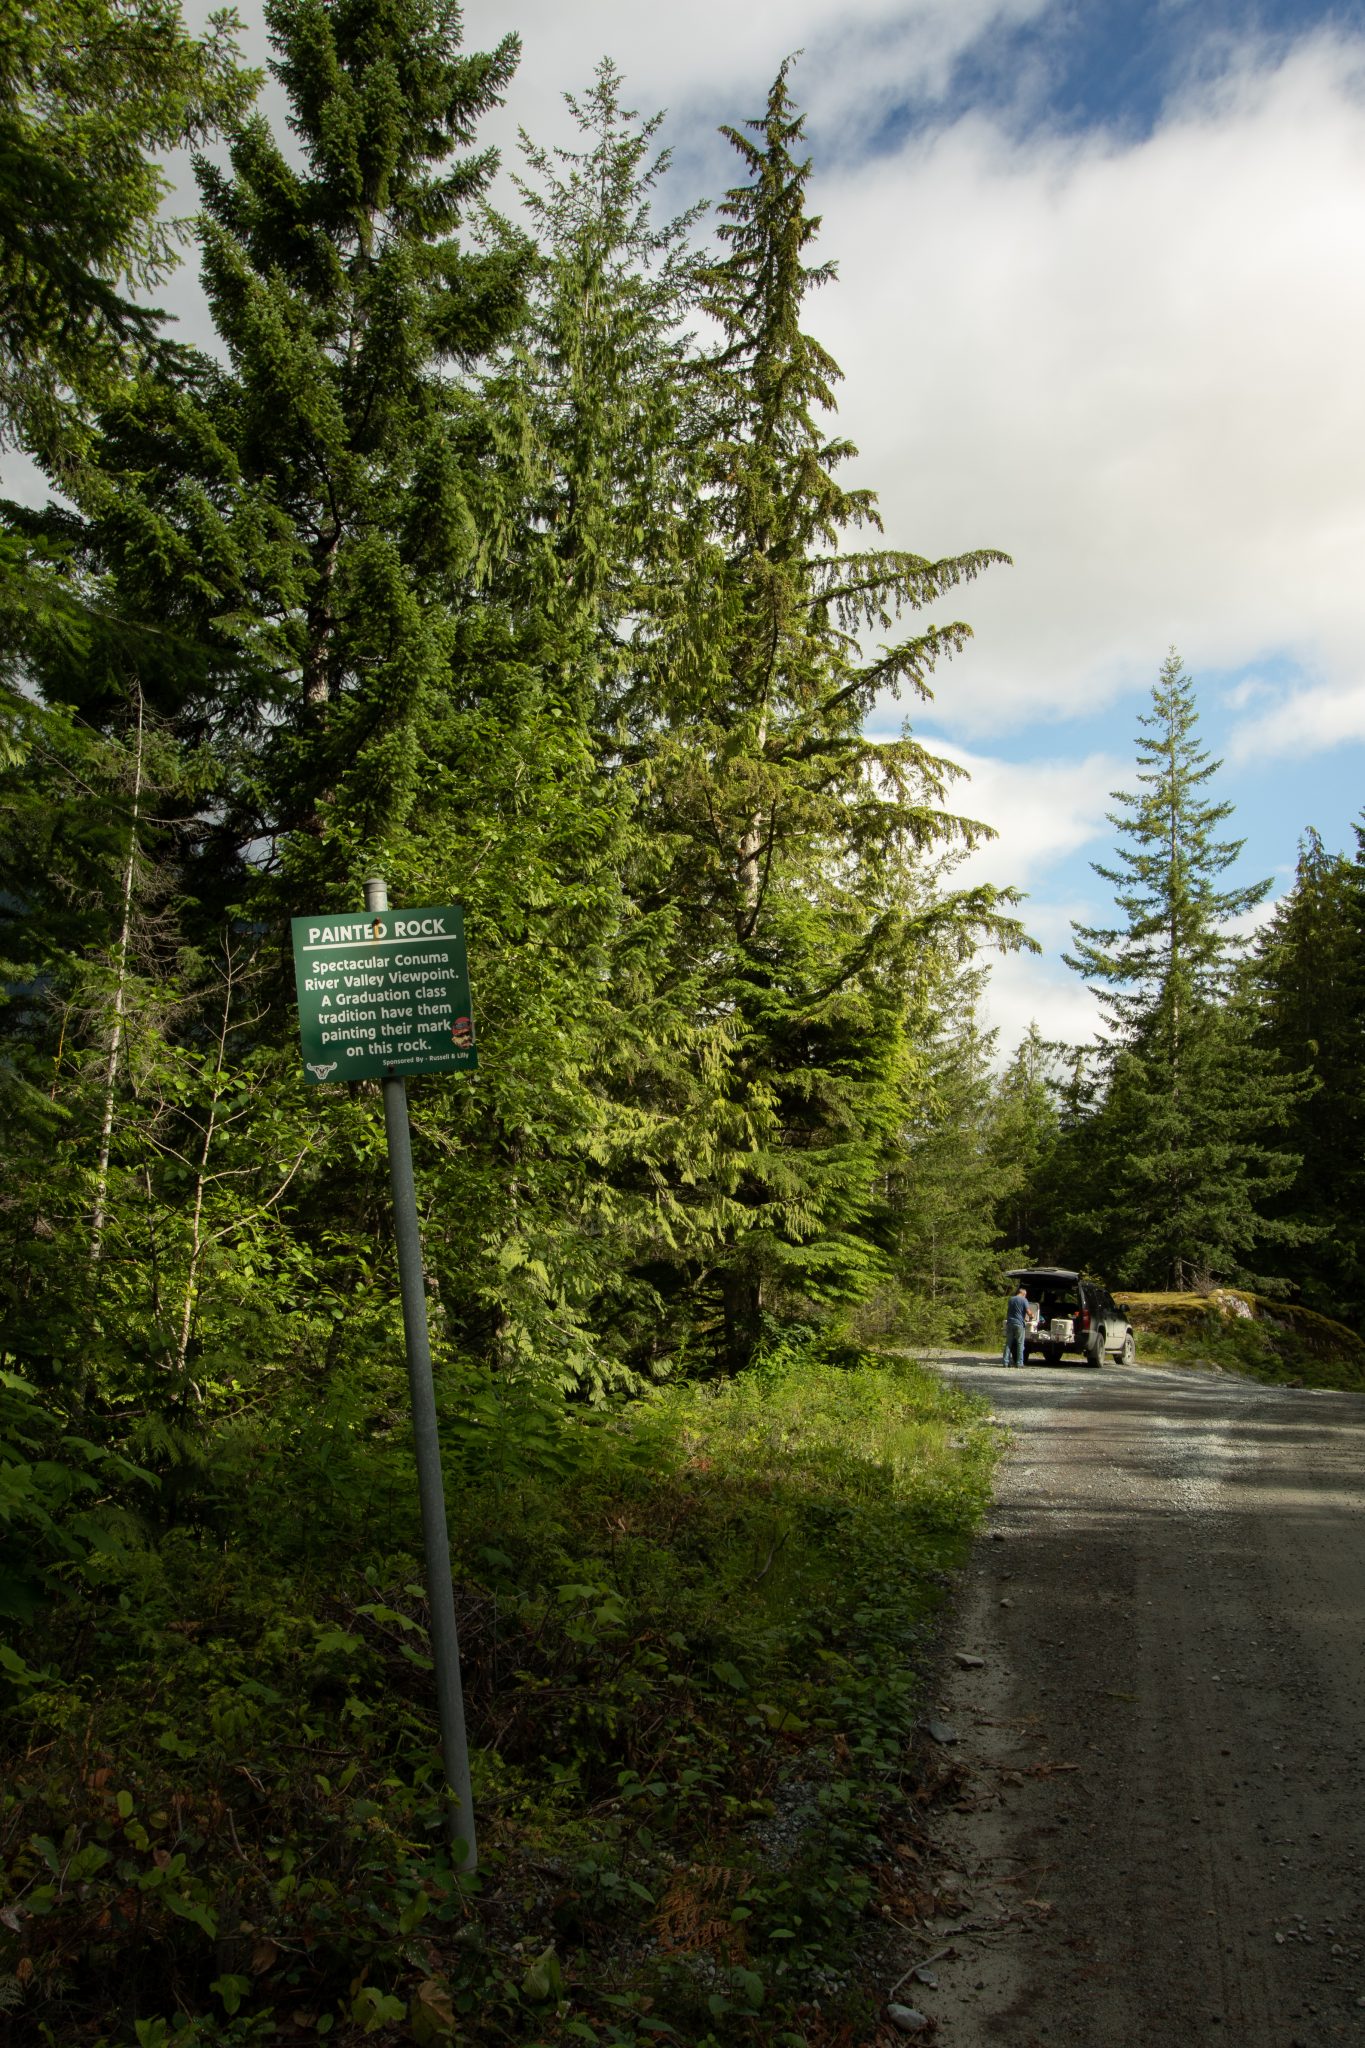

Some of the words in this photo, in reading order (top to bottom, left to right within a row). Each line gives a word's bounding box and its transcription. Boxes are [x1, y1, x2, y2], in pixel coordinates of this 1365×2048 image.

[309, 922, 387, 944] PAINTED
[395, 918, 446, 937] ROCK
[312, 956, 389, 975] Spectacular
[395, 952, 449, 965] Conuma
[305, 978, 339, 991] River
[344, 974, 384, 989] Valley
[389, 968, 459, 984] Viewpoint.
[322, 995, 331, 1007] A
[336, 989, 410, 1005] Graduation
[415, 985, 446, 997] class
[318, 1008, 376, 1024] tradition
[381, 1006, 413, 1019] have
[417, 1003, 452, 1015] them
[322, 1026, 376, 1044] painting
[381, 1023, 412, 1036] their
[417, 1019, 451, 1033] mark
[346, 1045, 363, 1057] on
[369, 1041, 393, 1054] this
[398, 1039, 431, 1052] rock.
[383, 1057, 414, 1066] Sponsored
